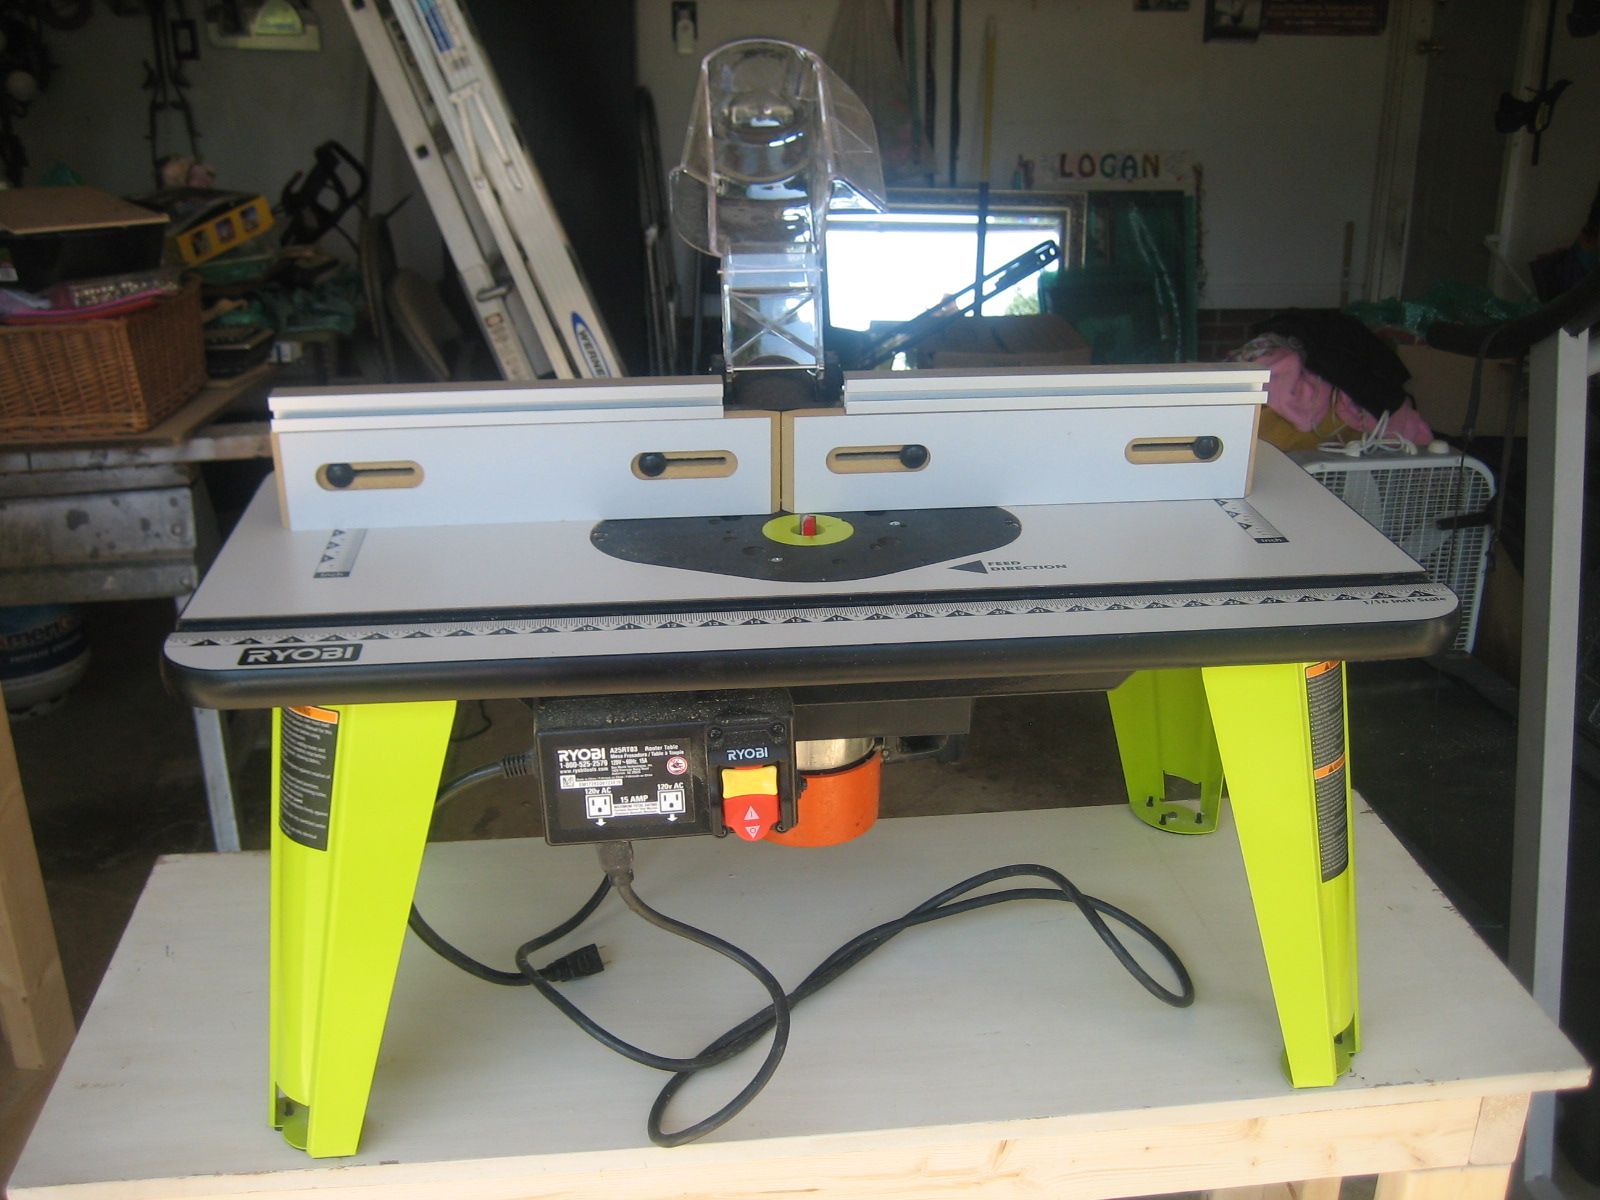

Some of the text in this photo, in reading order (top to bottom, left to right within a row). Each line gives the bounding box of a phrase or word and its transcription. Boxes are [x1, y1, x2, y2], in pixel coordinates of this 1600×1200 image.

[1059, 153, 1161, 180] LOGAN
[578, 330, 606, 376] WERNE
[245, 645, 354, 663] RYOBI
[557, 747, 606, 762] RYOBI
[727, 746, 769, 761] RYOBI
[601, 786, 612, 794] AC
[629, 795, 649, 803] AMP
